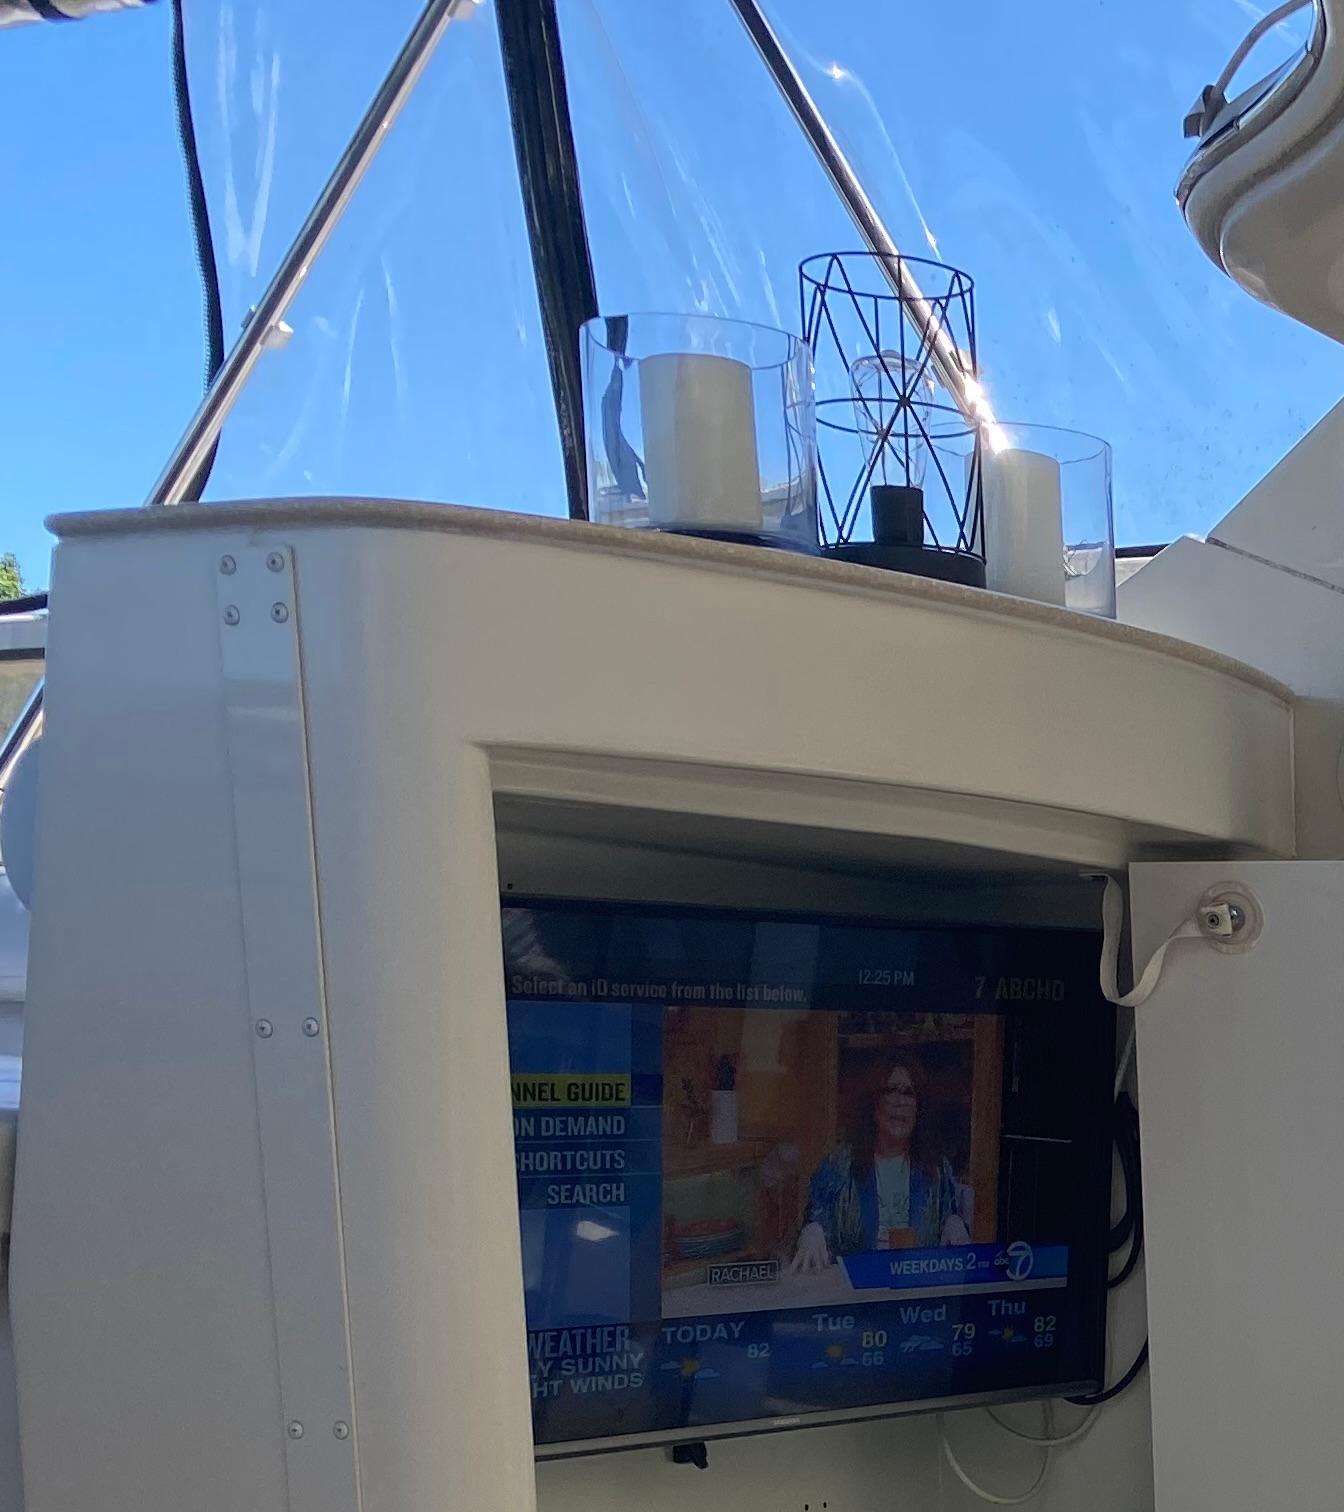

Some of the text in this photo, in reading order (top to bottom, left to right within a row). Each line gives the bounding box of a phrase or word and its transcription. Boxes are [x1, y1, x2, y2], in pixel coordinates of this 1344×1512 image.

[858, 969, 916, 987] 12:25 PM
[974, 976, 1066, 1001] 7 ABCHD
[671, 981, 706, 1001] from
[709, 983, 733, 1002] the
[737, 983, 760, 1002] list
[566, 1082, 626, 1103] GUIDE
[541, 1115, 626, 1137] DEMAND
[516, 1149, 626, 1171] HORTCUTS
[546, 1182, 626, 1205] SEARCH
[711, 1264, 775, 1284] RACHAEL
[889, 1257, 964, 1276] WEEKDAYS
[966, 1252, 977, 1271] 2
[898, 1303, 947, 1326] Wed
[986, 1299, 1027, 1318] Thu
[660, 1320, 747, 1345] TODAY
[811, 1313, 856, 1333] Tue
[951, 1322, 976, 1342] 79
[1033, 1316, 1057, 1334] 82
[746, 1343, 771, 1359] 82
[559, 1351, 644, 1377] SUNNY
[569, 1371, 644, 1394] WINDS
